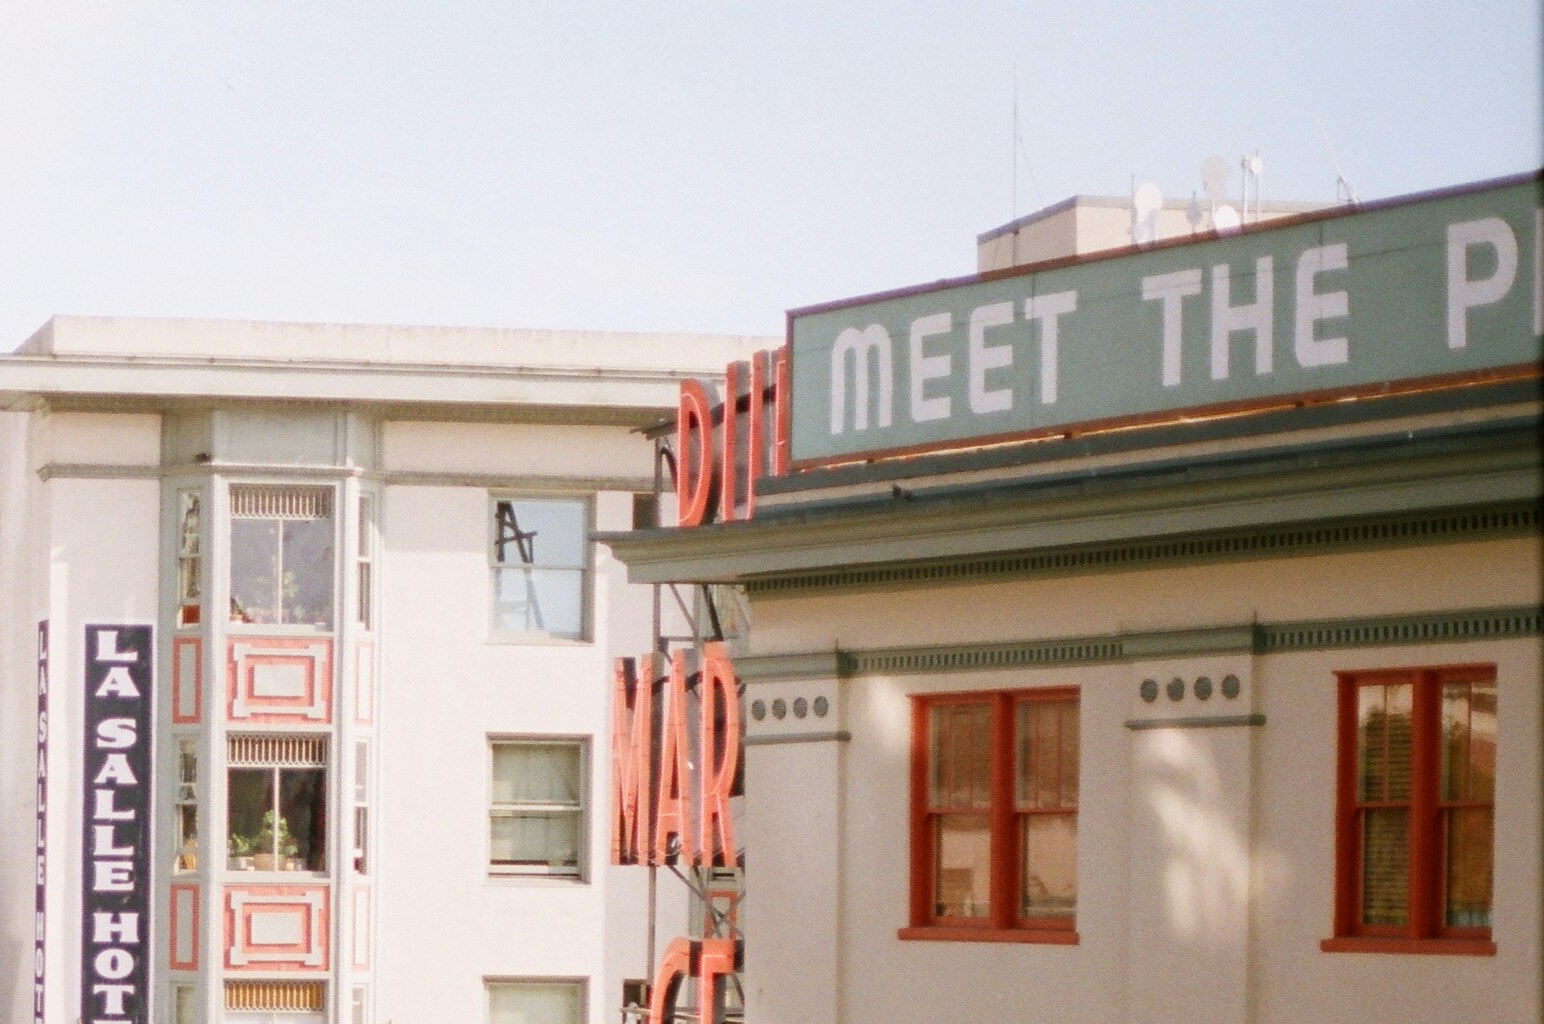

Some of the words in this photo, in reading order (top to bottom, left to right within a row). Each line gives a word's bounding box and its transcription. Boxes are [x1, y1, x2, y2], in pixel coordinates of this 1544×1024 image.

[829, 290, 1077, 436] MEET
[1142, 242, 1350, 388] THE
[1446, 205, 1544, 349] P
[95, 630, 139, 698] LA
[93, 717, 138, 893] SALLE
